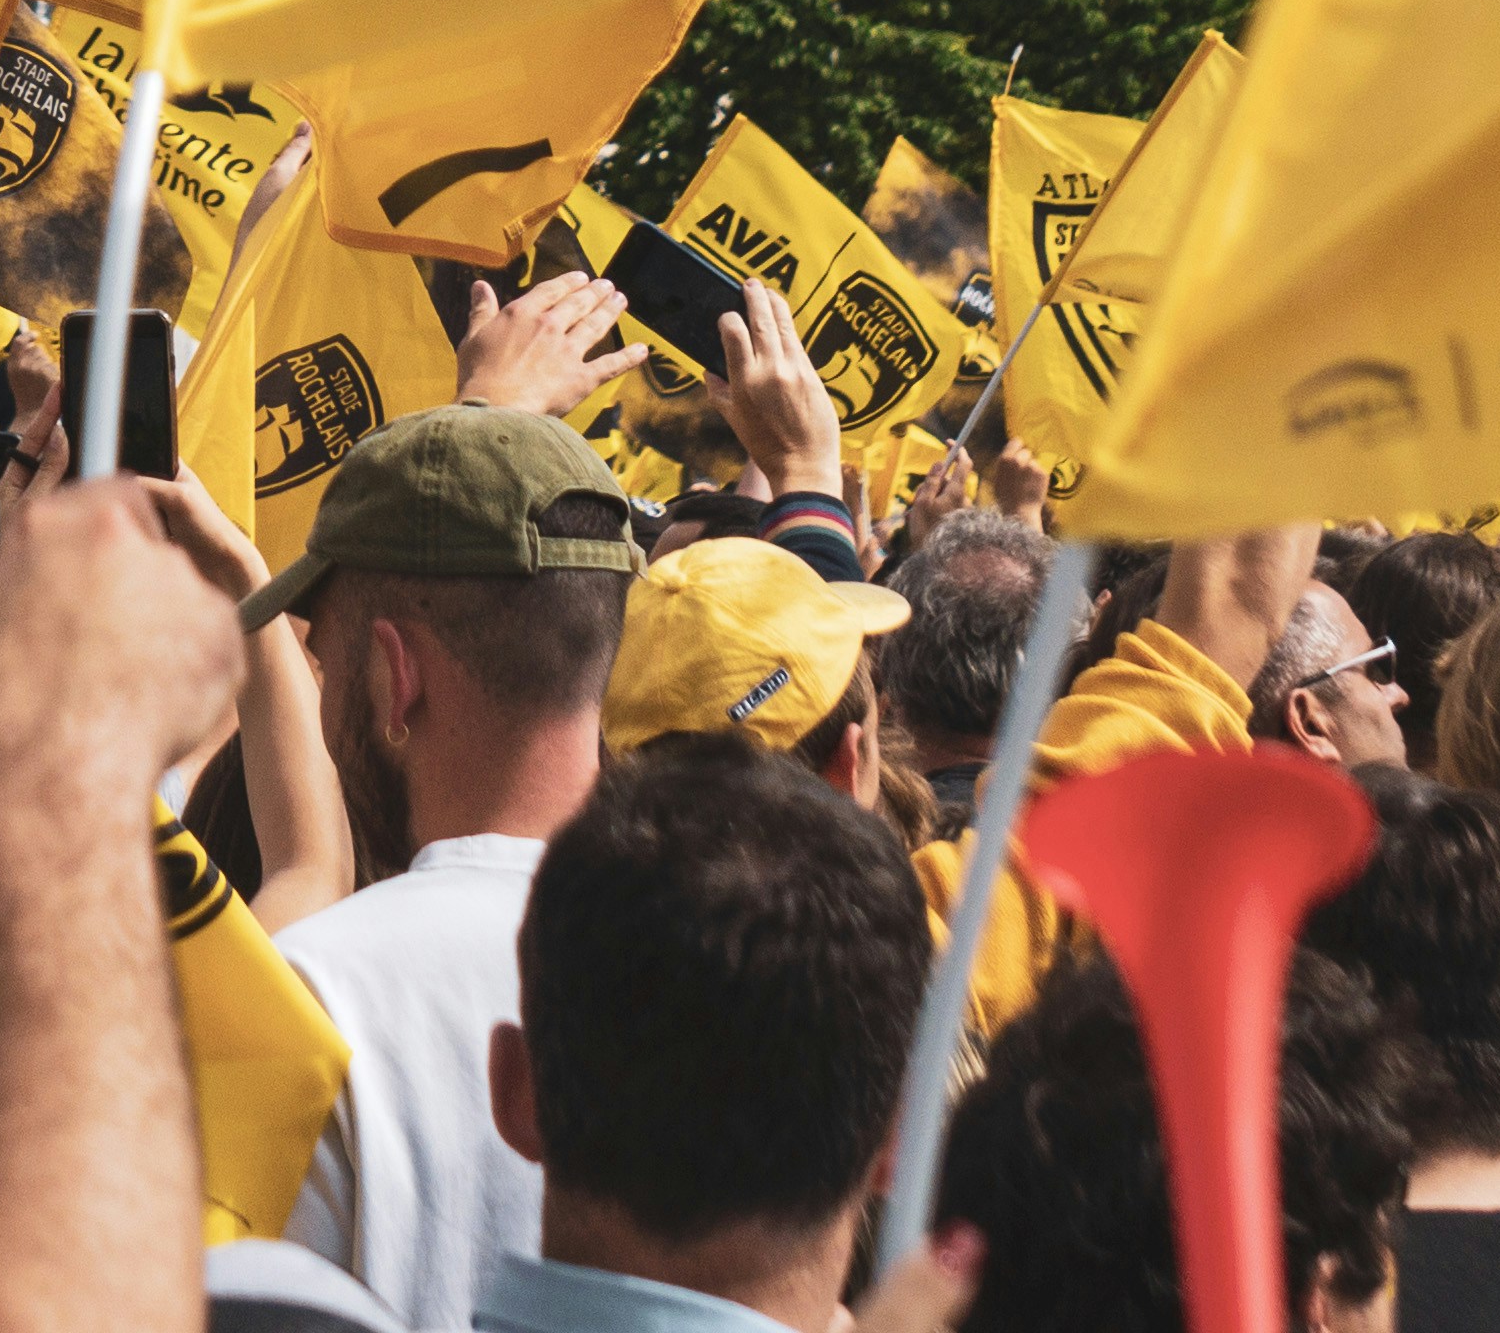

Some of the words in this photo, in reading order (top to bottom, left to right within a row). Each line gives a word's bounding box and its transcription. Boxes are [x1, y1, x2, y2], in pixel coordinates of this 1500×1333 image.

[14, 55, 53, 87] STADE
[836, 290, 919, 380] ROCHELAIS
[287, 351, 353, 460] ROCHELAIS
[329, 366, 362, 416] STADE
